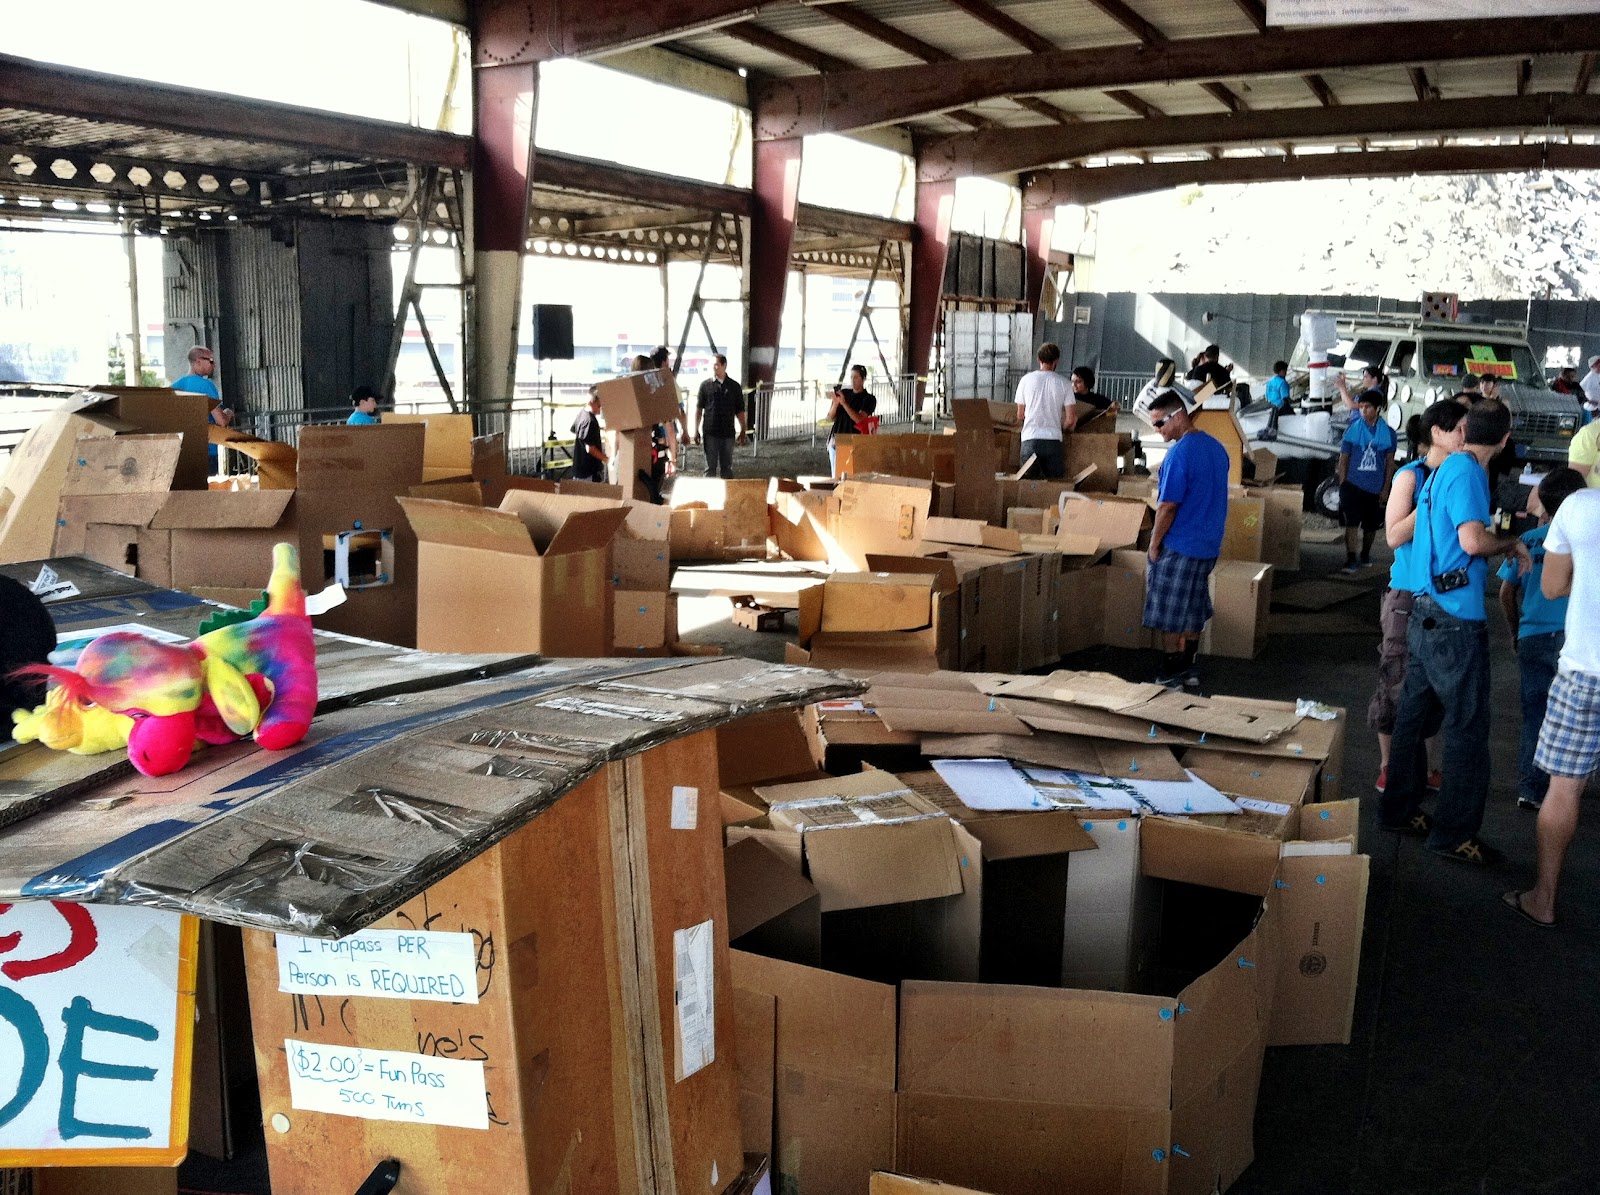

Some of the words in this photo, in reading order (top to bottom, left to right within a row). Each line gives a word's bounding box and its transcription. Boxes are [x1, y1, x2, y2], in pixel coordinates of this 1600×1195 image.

[397, 935, 431, 960] PER
[288, 961, 337, 987] Person
[347, 972, 361, 987] is
[370, 969, 465, 998] REQUIRED
[297, 1046, 355, 1074] $2.00
